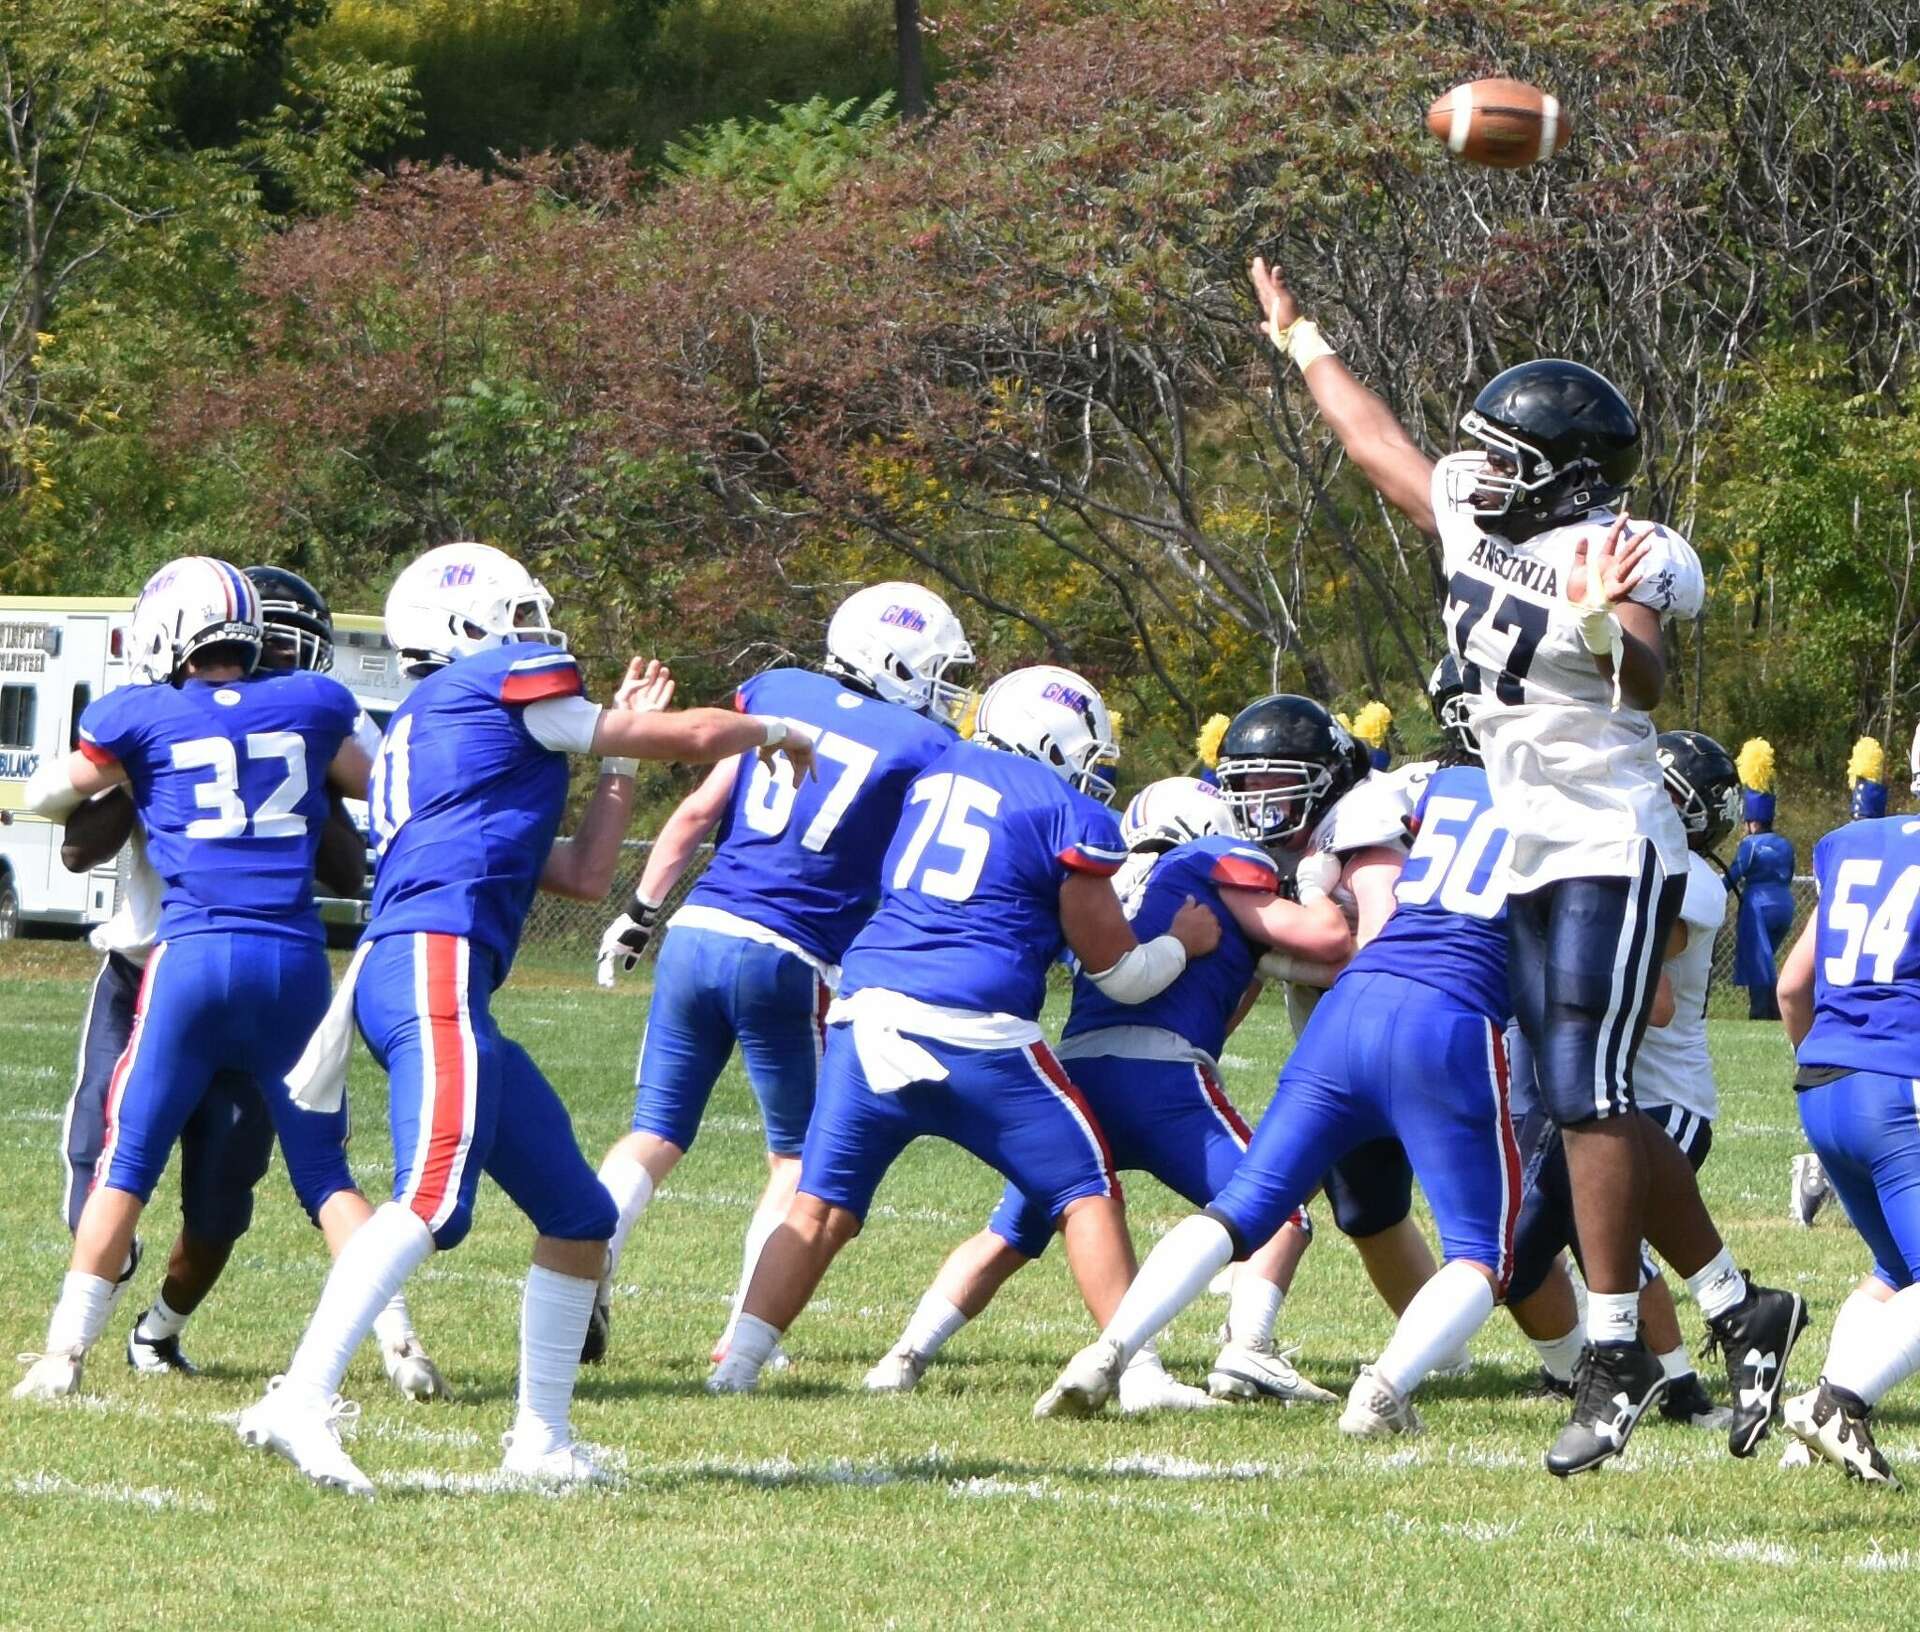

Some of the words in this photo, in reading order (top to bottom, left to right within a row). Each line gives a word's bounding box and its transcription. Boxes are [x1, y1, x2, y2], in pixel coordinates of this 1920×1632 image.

[1467, 538, 1558, 598] ANSONIA
[1447, 569, 1551, 706] 77
[171, 731, 309, 839] 32
[893, 772, 1002, 901] 75
[1394, 796, 1514, 918] 50
[1825, 859, 1920, 986] 54
